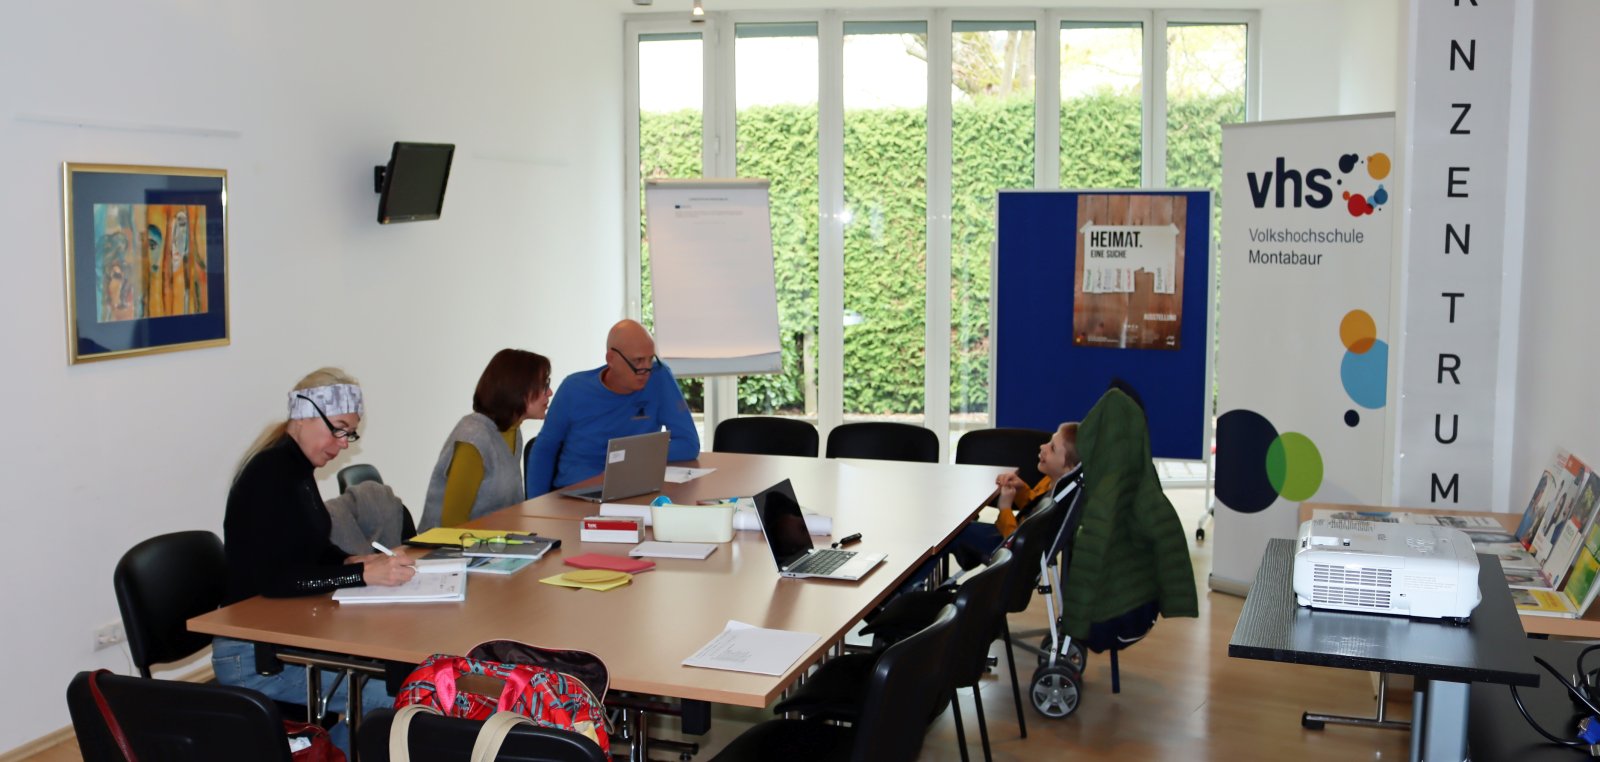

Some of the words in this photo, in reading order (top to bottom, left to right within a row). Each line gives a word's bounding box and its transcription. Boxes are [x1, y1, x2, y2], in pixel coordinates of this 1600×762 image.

[1246, 156, 1333, 209] vhs
[1090, 231, 1143, 248] HEIMAT.
[1248, 228, 1364, 244] Volkshochschule
[1090, 250, 1105, 258] EINE
[1106, 249, 1127, 258] SUCHE
[1248, 249, 1323, 265] Montabaur
[1430, 0, 1478, 503] NZENTRUM
